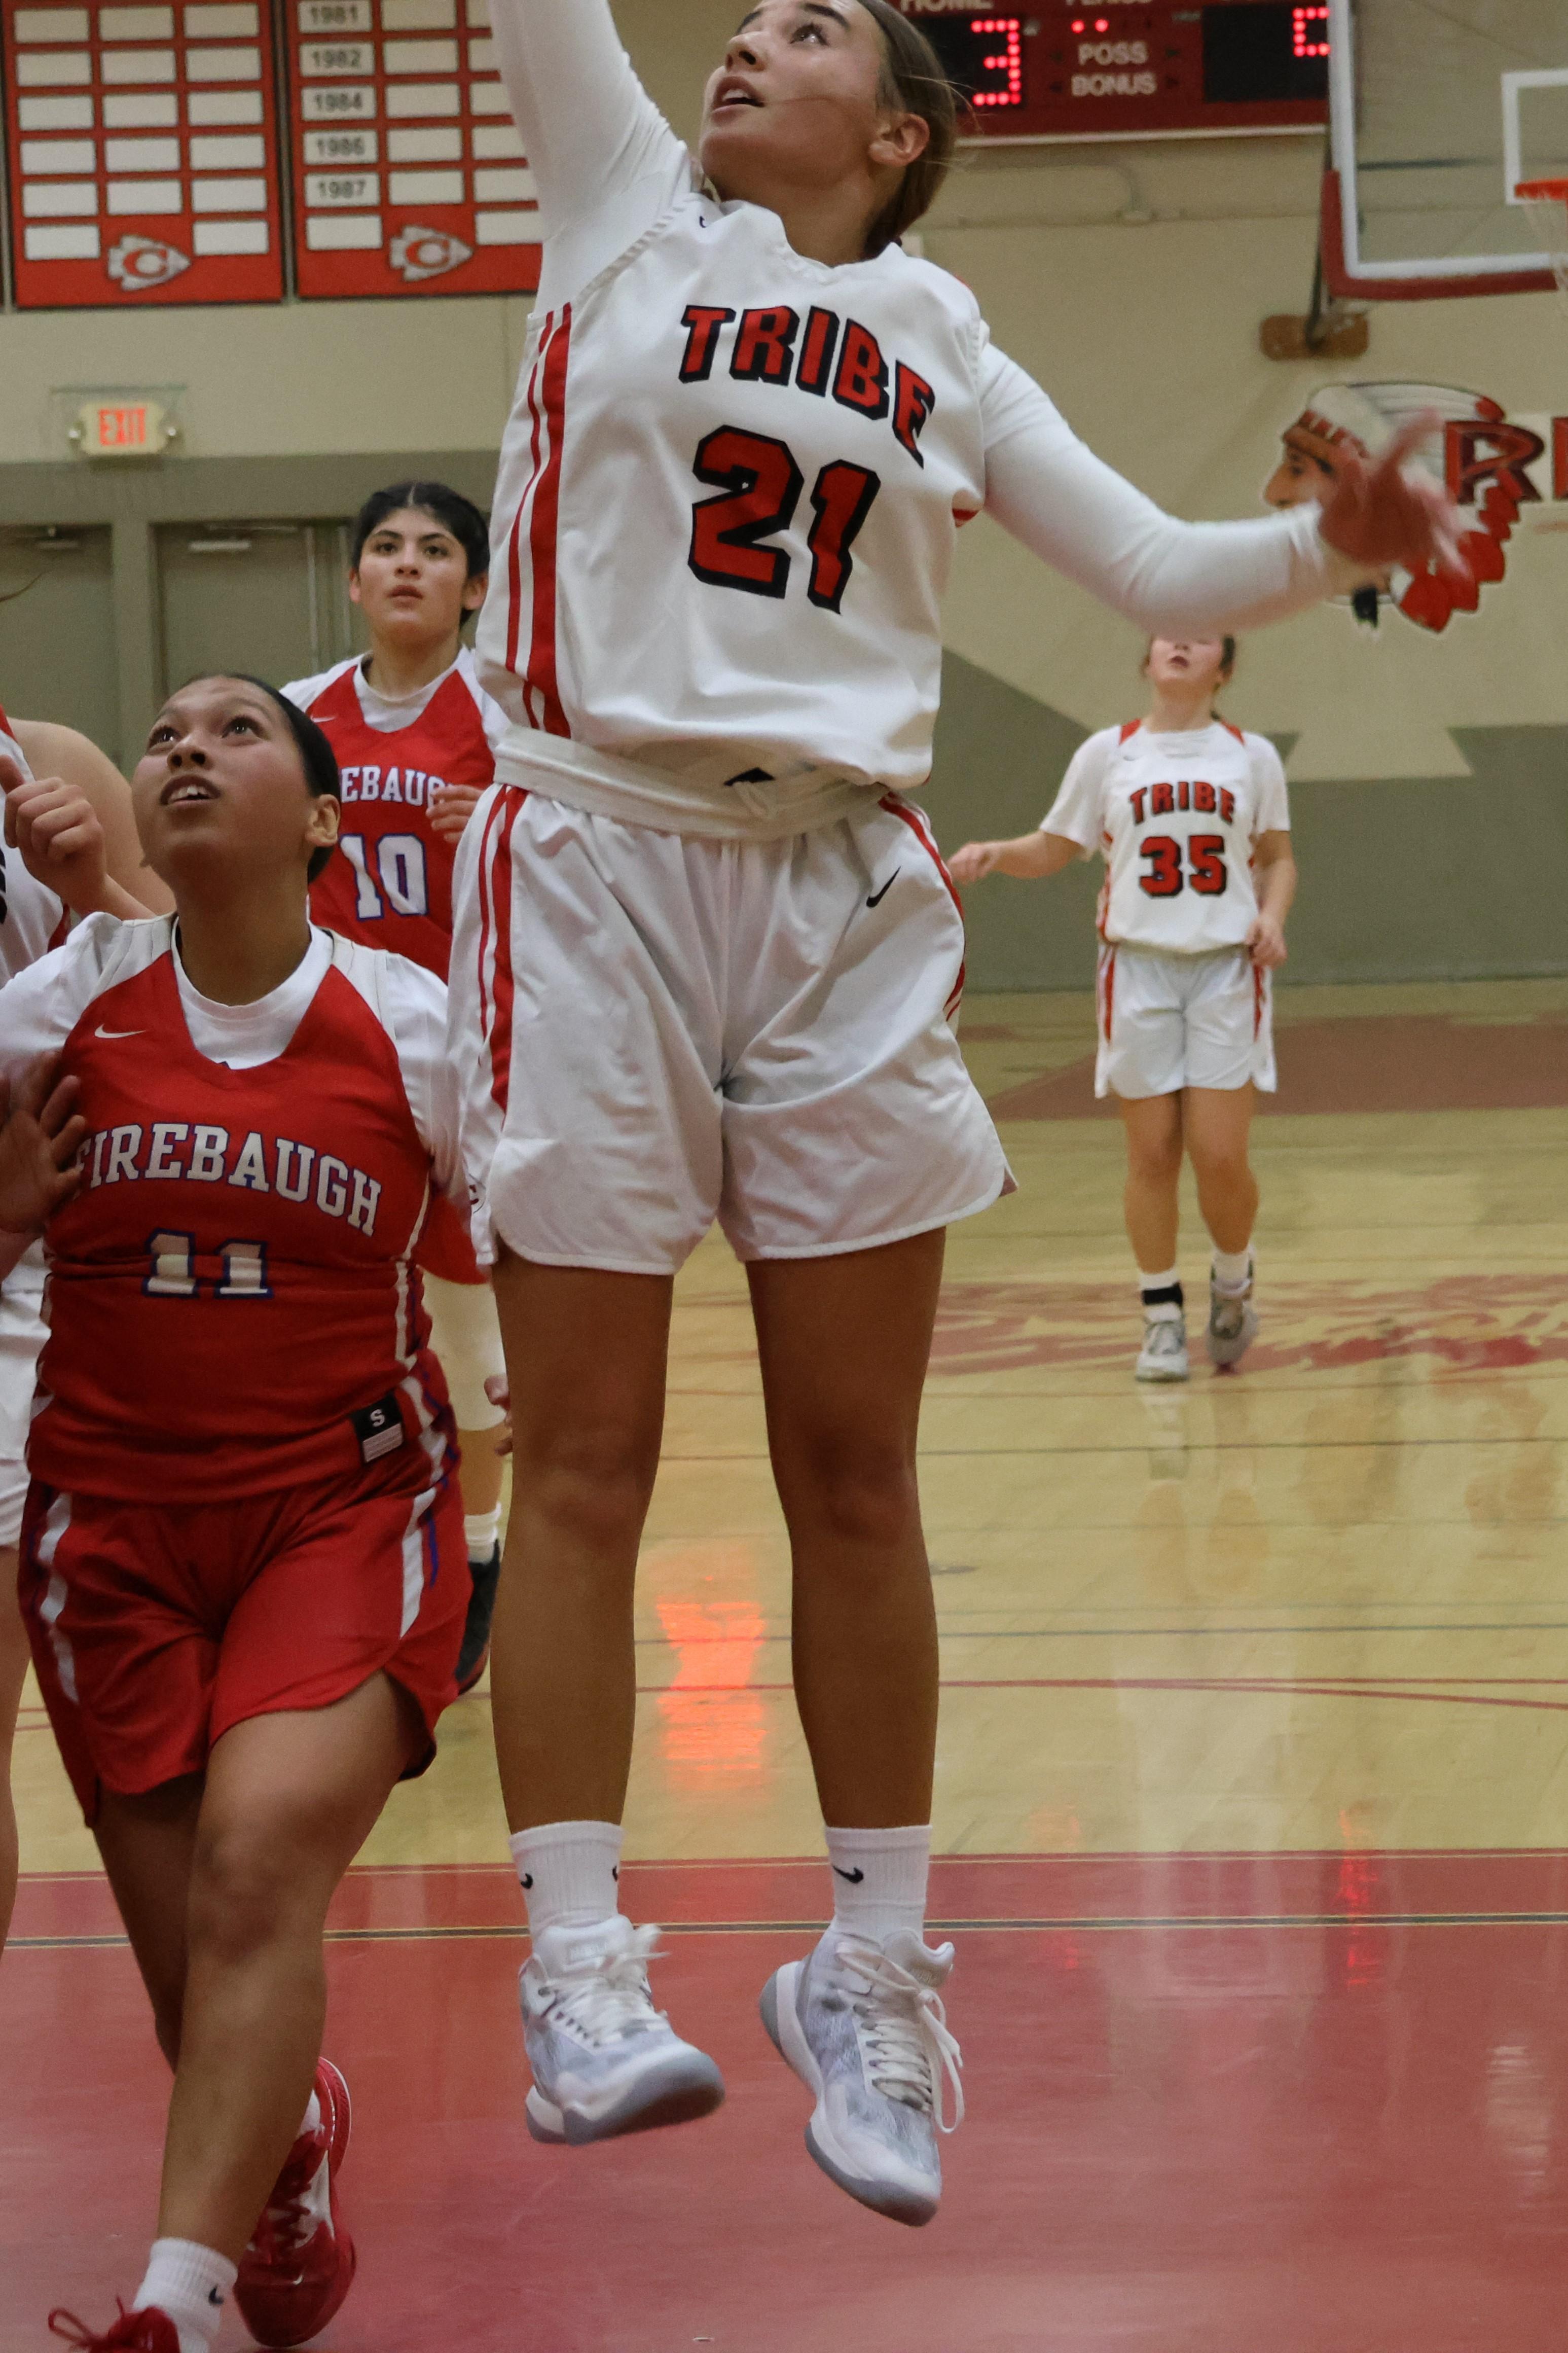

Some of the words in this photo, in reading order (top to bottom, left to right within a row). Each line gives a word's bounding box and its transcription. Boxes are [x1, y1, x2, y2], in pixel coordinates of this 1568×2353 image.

[1078, 41, 1148, 65] POSS
[1071, 72, 1156, 96] BONUS
[678, 305, 935, 469] TRIBE
[98, 408, 147, 446] EXIT
[688, 424, 881, 615] 21
[1129, 781, 1235, 825] TRIBE
[340, 833, 430, 920] 10
[1139, 835, 1227, 898] 35
[143, 1227, 274, 1299] 11
[370, 1409, 386, 1427] S
